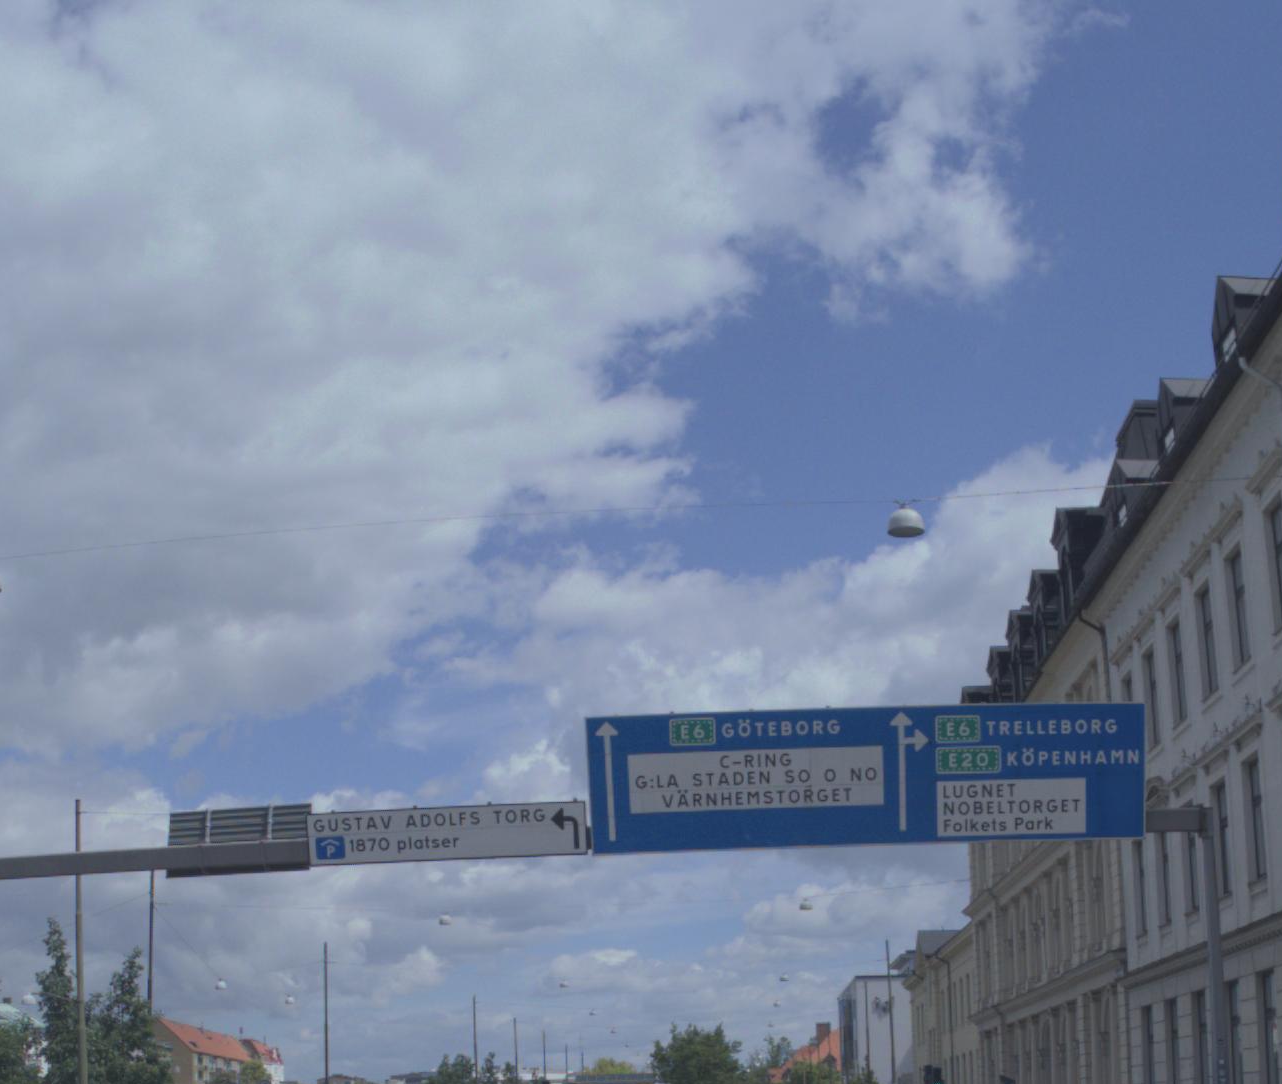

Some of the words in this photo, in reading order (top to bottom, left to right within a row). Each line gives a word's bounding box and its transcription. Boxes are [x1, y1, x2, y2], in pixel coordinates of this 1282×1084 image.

[680, 726, 705, 739] E6
[722, 719, 841, 739] GÖTEBORG
[946, 721, 971, 737] E6
[986, 719, 1118, 737] TRELLEBORG
[720, 753, 792, 769] C-RING
[948, 753, 989, 767] E20
[1007, 748, 1140, 767] KÖPENHAMN
[635, 774, 679, 790] G:LA
[693, 771, 771, 786] STADEN
[785, 769, 811, 784] SO
[824, 768, 837, 783] O
[850, 767, 877, 782] NO
[662, 787, 853, 809] VÄRNHEMSTORGET
[942, 783, 1017, 799] LUGNET
[943, 799, 1081, 816] NOBELTORGET
[313, 815, 393, 833] GUSTAV
[405, 811, 481, 828] ADOLFS
[493, 807, 547, 825] TORG
[943, 818, 1007, 833] Folkets
[1014, 816, 1054, 831] Park
[349, 837, 390, 852] 1870
[397, 835, 460, 854] platser
